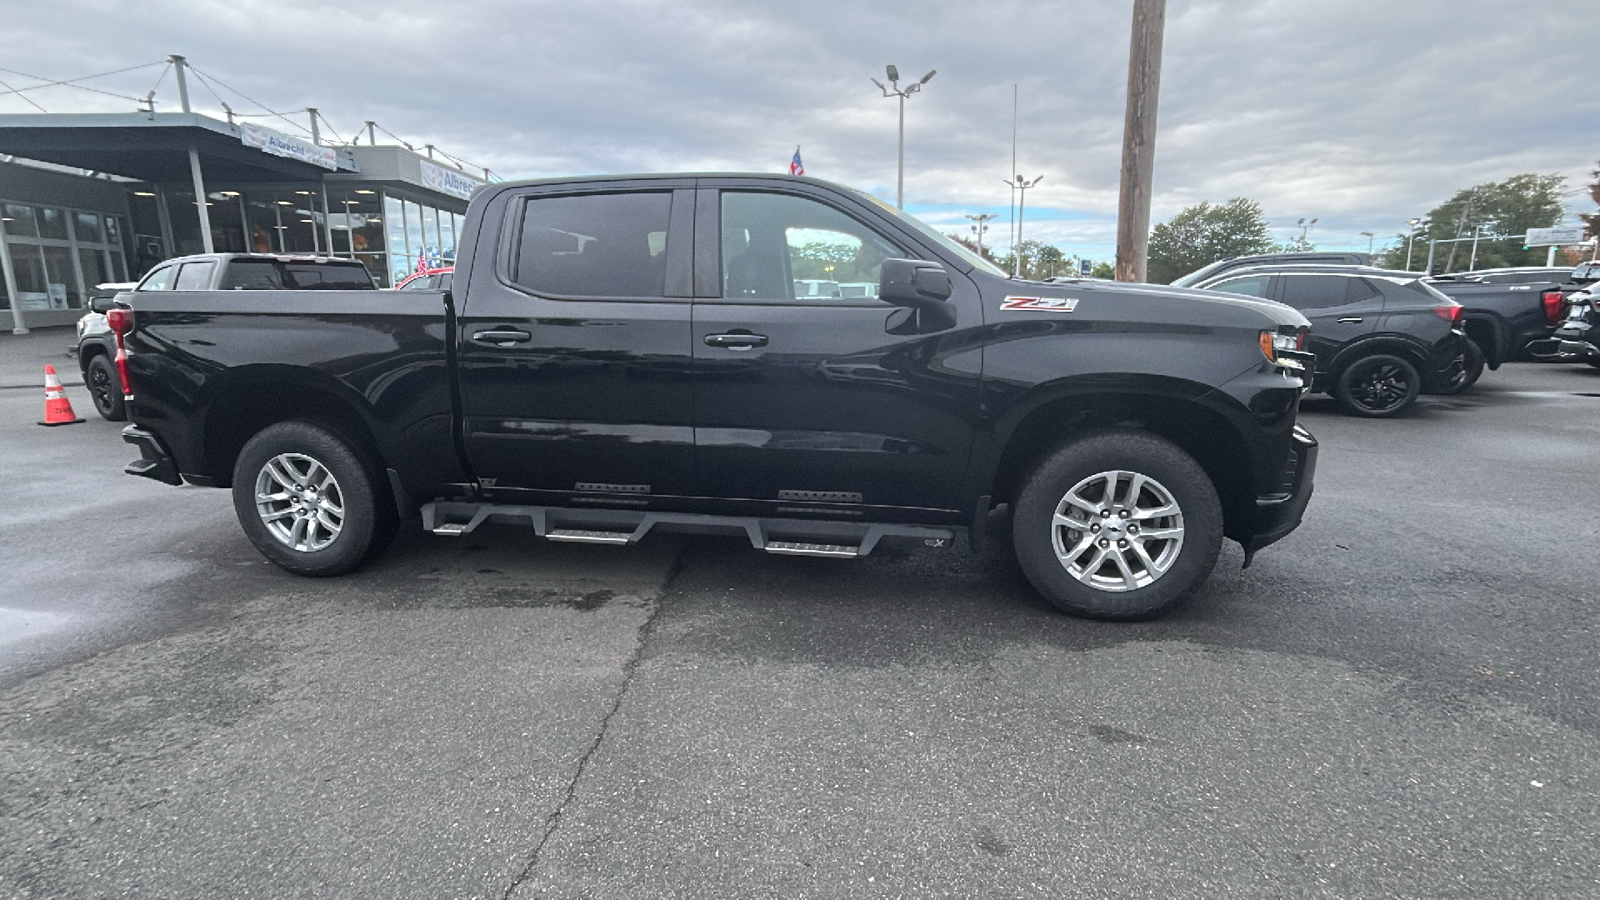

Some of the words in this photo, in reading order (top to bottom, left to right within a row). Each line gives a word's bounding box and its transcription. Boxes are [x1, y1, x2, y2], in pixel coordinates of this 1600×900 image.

[269, 136, 305, 156] Albrecht
[444, 171, 475, 193] Albrec
[999, 295, 1079, 313] Z71
